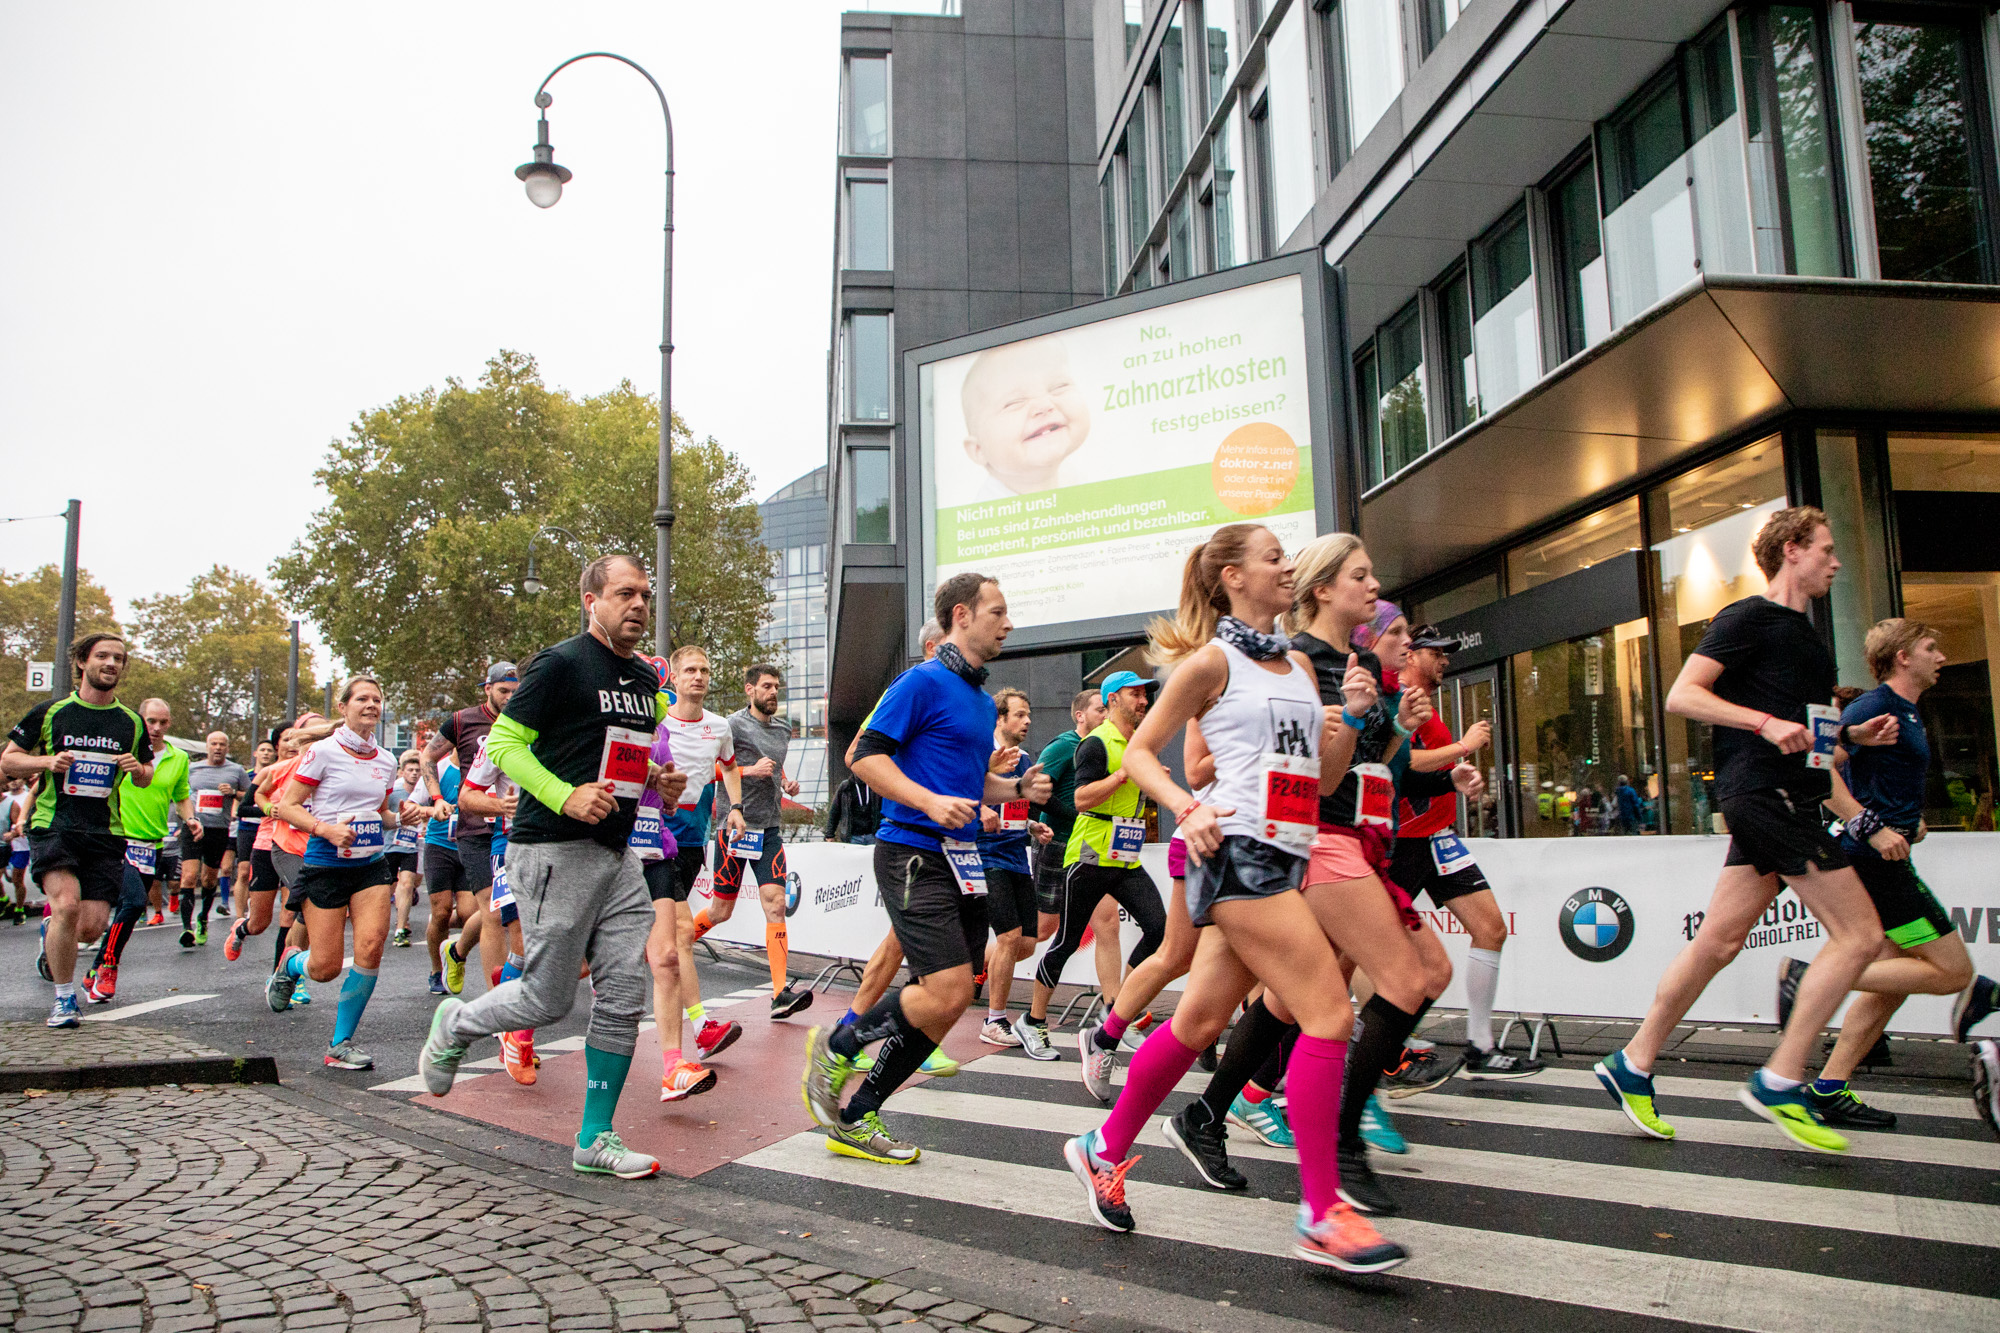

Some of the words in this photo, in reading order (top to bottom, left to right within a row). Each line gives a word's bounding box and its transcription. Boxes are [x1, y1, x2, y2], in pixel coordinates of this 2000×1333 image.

[1139, 325, 1172, 343] Na,
[1123, 352, 1148, 369] an
[1152, 347, 1174, 363] zu
[1179, 332, 1242, 357] hohen
[1103, 355, 1287, 412] Zahnarztkosten
[1151, 393, 1287, 434] festgebissen?
[1220, 445, 1244, 454] Mehr
[1245, 445, 1268, 455] Infos
[1270, 447, 1296, 456] unter
[1219, 457, 1293, 470] doktor-z.net
[1223, 474, 1246, 483] oder
[1247, 474, 1274, 484] direkt
[1275, 476, 1285, 484] in
[1218, 489, 1253, 498] unserer
[1254, 489, 1286, 499] Praxis!
[956, 505, 994, 524] Nicht
[997, 499, 1023, 518] mit
[1025, 493, 1057, 513] uns!
[956, 528, 976, 542] Bei
[978, 524, 1001, 539] uns
[1002, 518, 1030, 535] sind
[1031, 499, 1167, 530] Zahnbehandlungen
[956, 536, 1029, 559] kompetent,
[1031, 524, 1100, 549] persönlich
[1103, 519, 1130, 536] und
[1133, 509, 1210, 531] bezahlbar.
[32, 672, 44, 687] B
[598, 689, 656, 718] BERLIN
[75, 762, 111, 776] 20783
[78, 776, 105, 785] Carsten
[347, 822, 380, 835] 18495
[634, 819, 660, 834] 0222
[631, 836, 652, 845] Diana
[1118, 828, 1143, 840] 25123
[357, 838, 371, 846] Anja
[824, 894, 859, 914] ALKOHOLFREI
[588, 1079, 608, 1090] DFB
